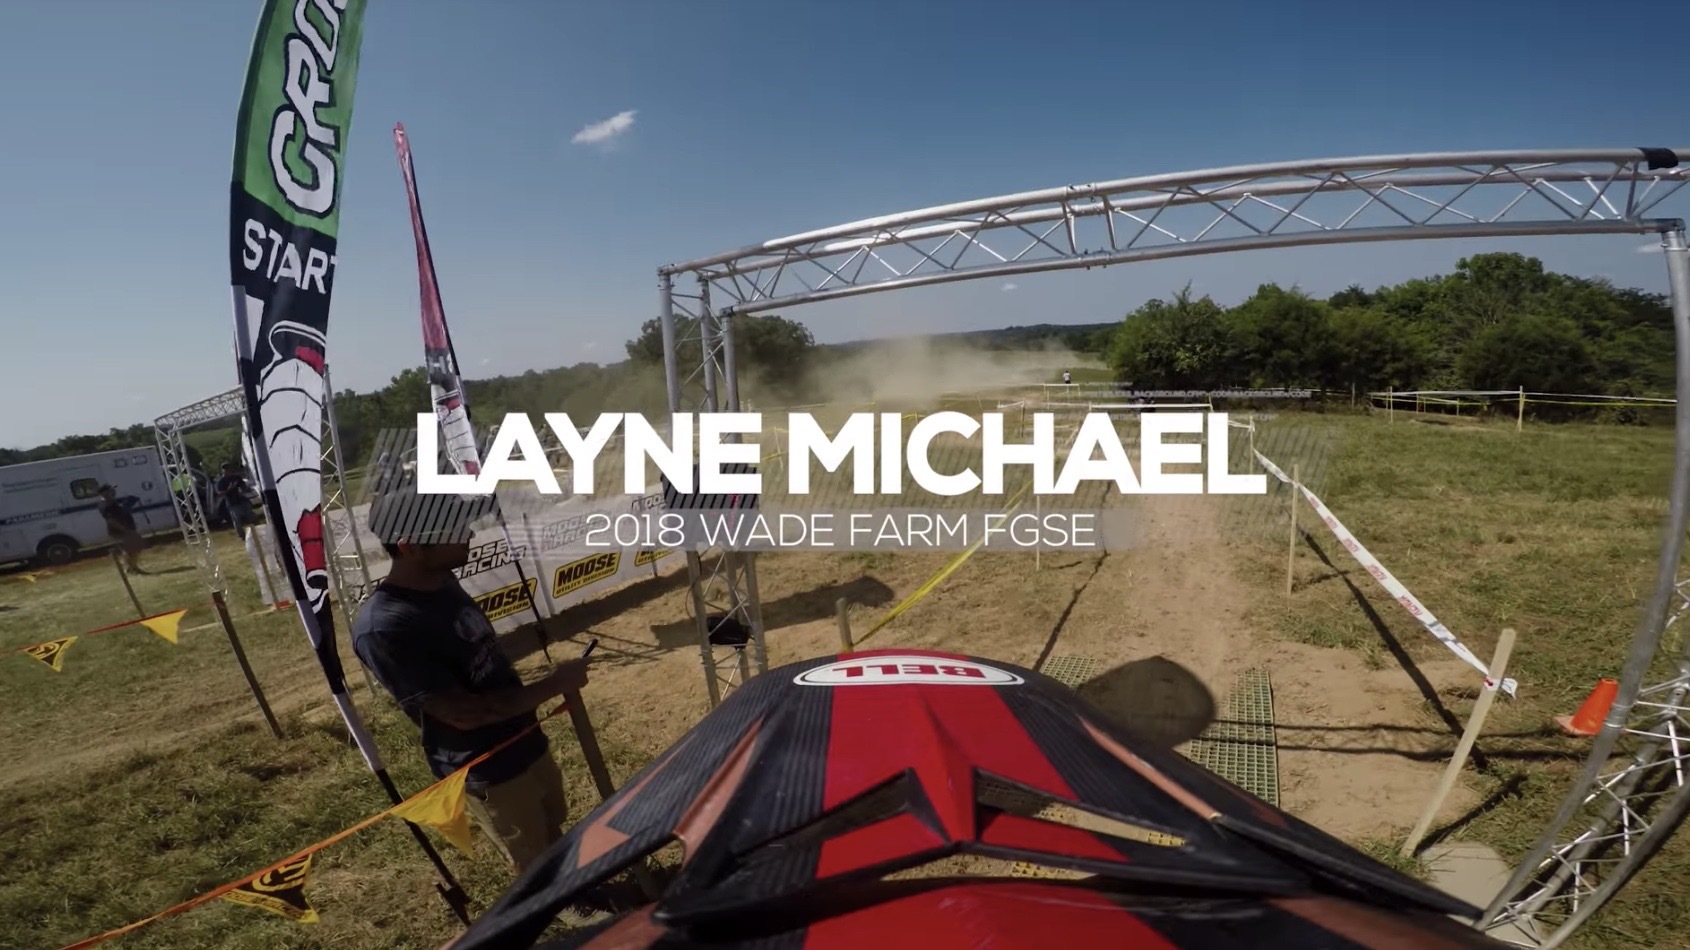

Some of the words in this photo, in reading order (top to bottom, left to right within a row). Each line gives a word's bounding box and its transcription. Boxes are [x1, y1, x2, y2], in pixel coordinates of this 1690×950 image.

[268, 0, 347, 218] CRO
[468, 539, 509, 563] OSE
[557, 552, 617, 588] MOOSE
[479, 583, 532, 613] OOSE
[832, 664, 986, 679] BELL
